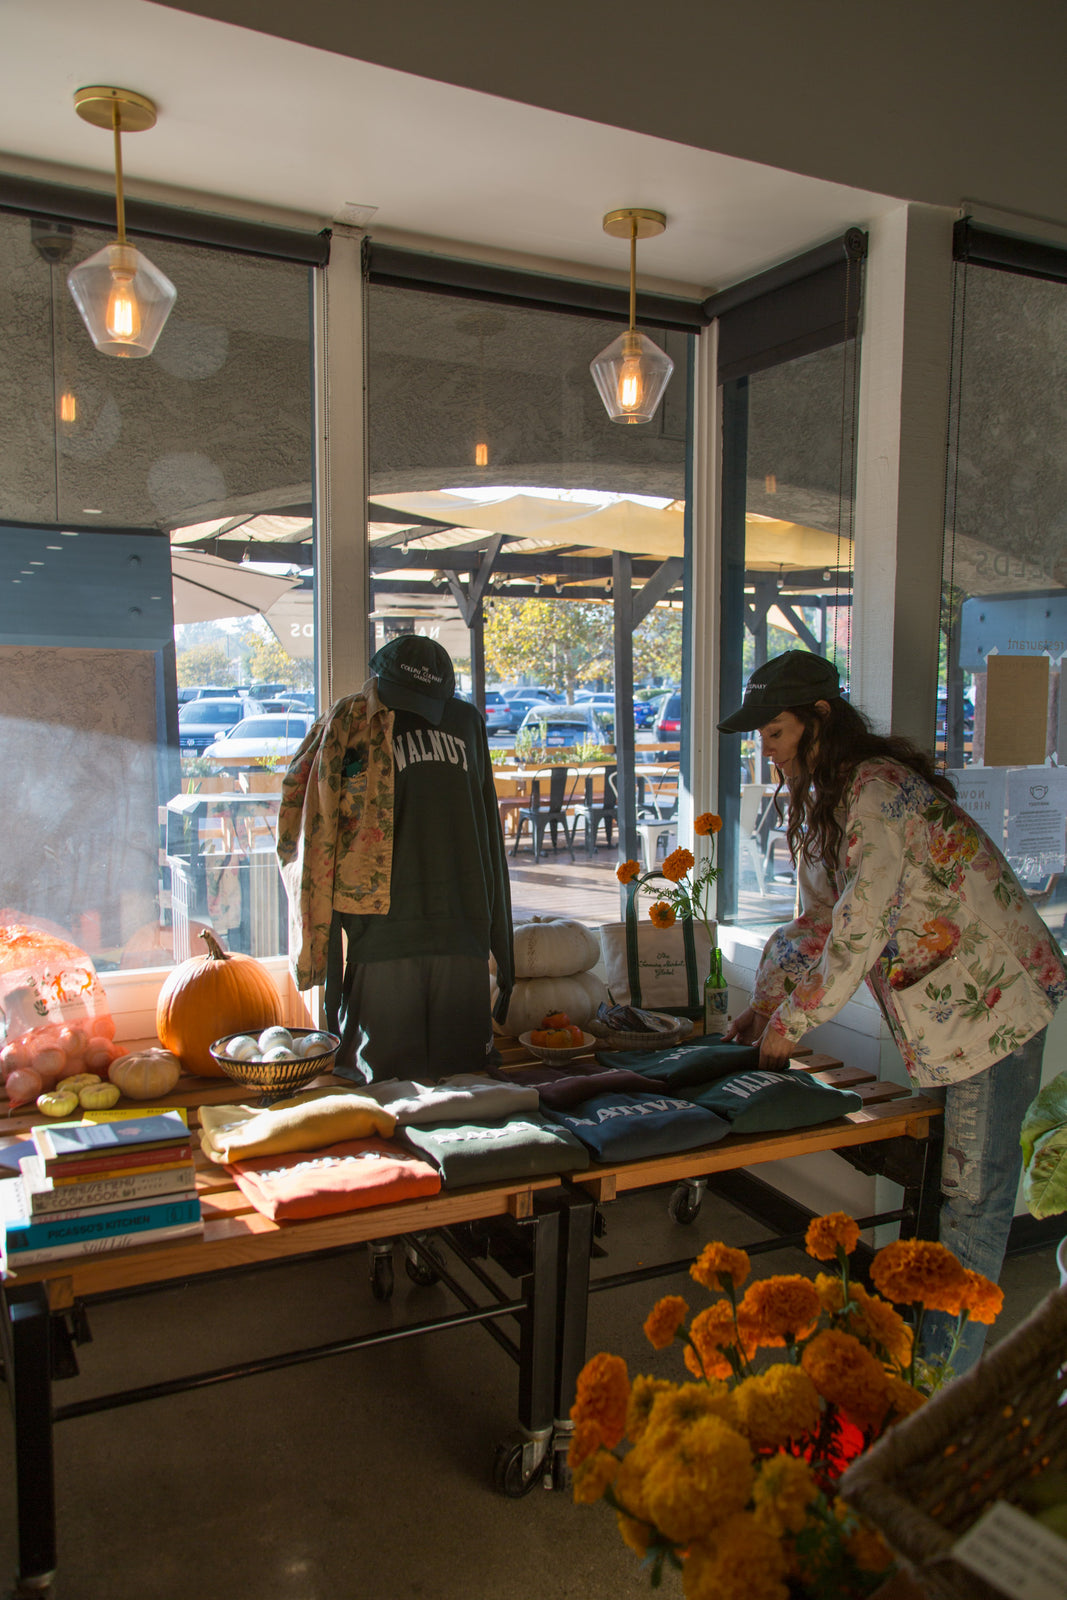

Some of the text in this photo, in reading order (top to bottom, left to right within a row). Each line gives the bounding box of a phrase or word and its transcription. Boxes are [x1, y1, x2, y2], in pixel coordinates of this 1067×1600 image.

[392, 729, 469, 773] WALNUT
[47, 1214, 150, 1240] PICASSO'S KITCHEN
